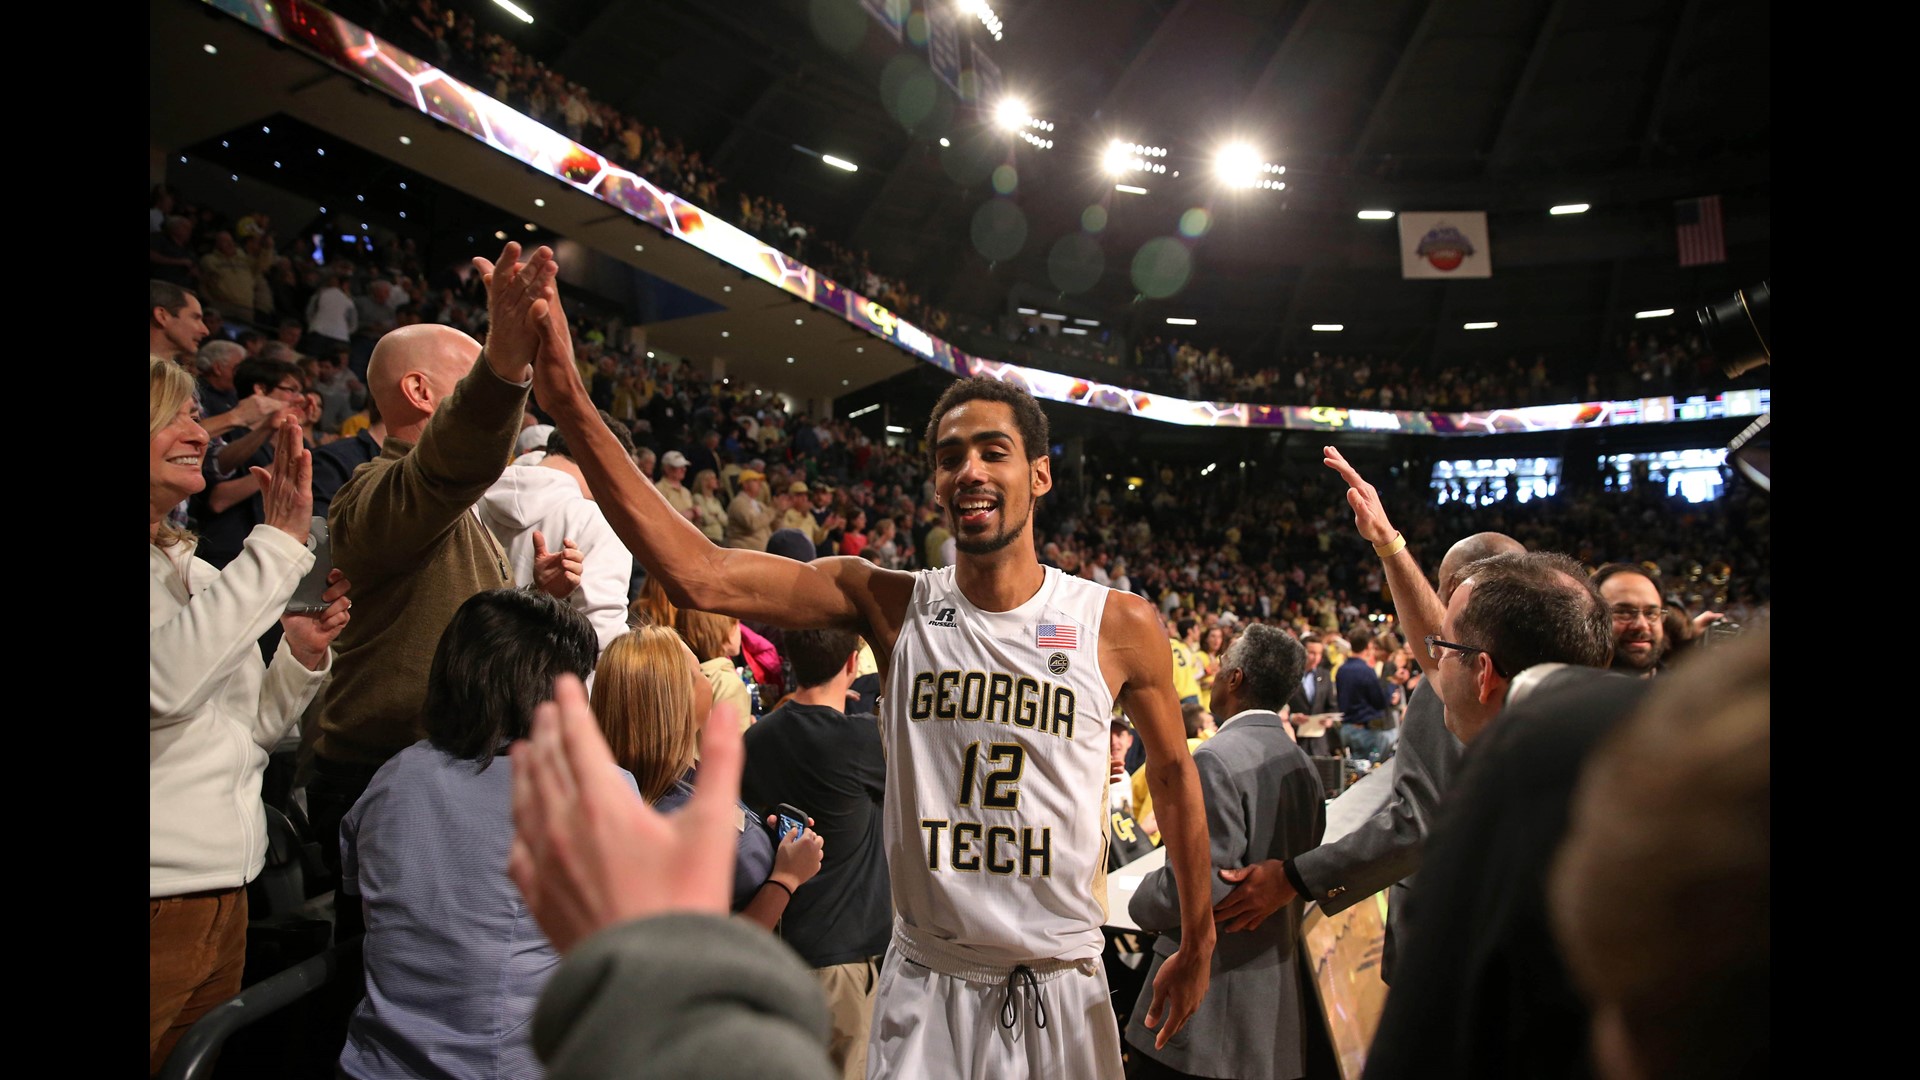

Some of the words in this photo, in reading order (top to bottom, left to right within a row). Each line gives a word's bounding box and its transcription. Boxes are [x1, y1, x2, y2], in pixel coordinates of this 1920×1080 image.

[928, 620, 957, 628] RUSSELL
[1173, 648, 1186, 667] 3
[910, 669, 1076, 741] GEORGIA
[958, 740, 1026, 811] 12
[919, 818, 1052, 878] TECH
